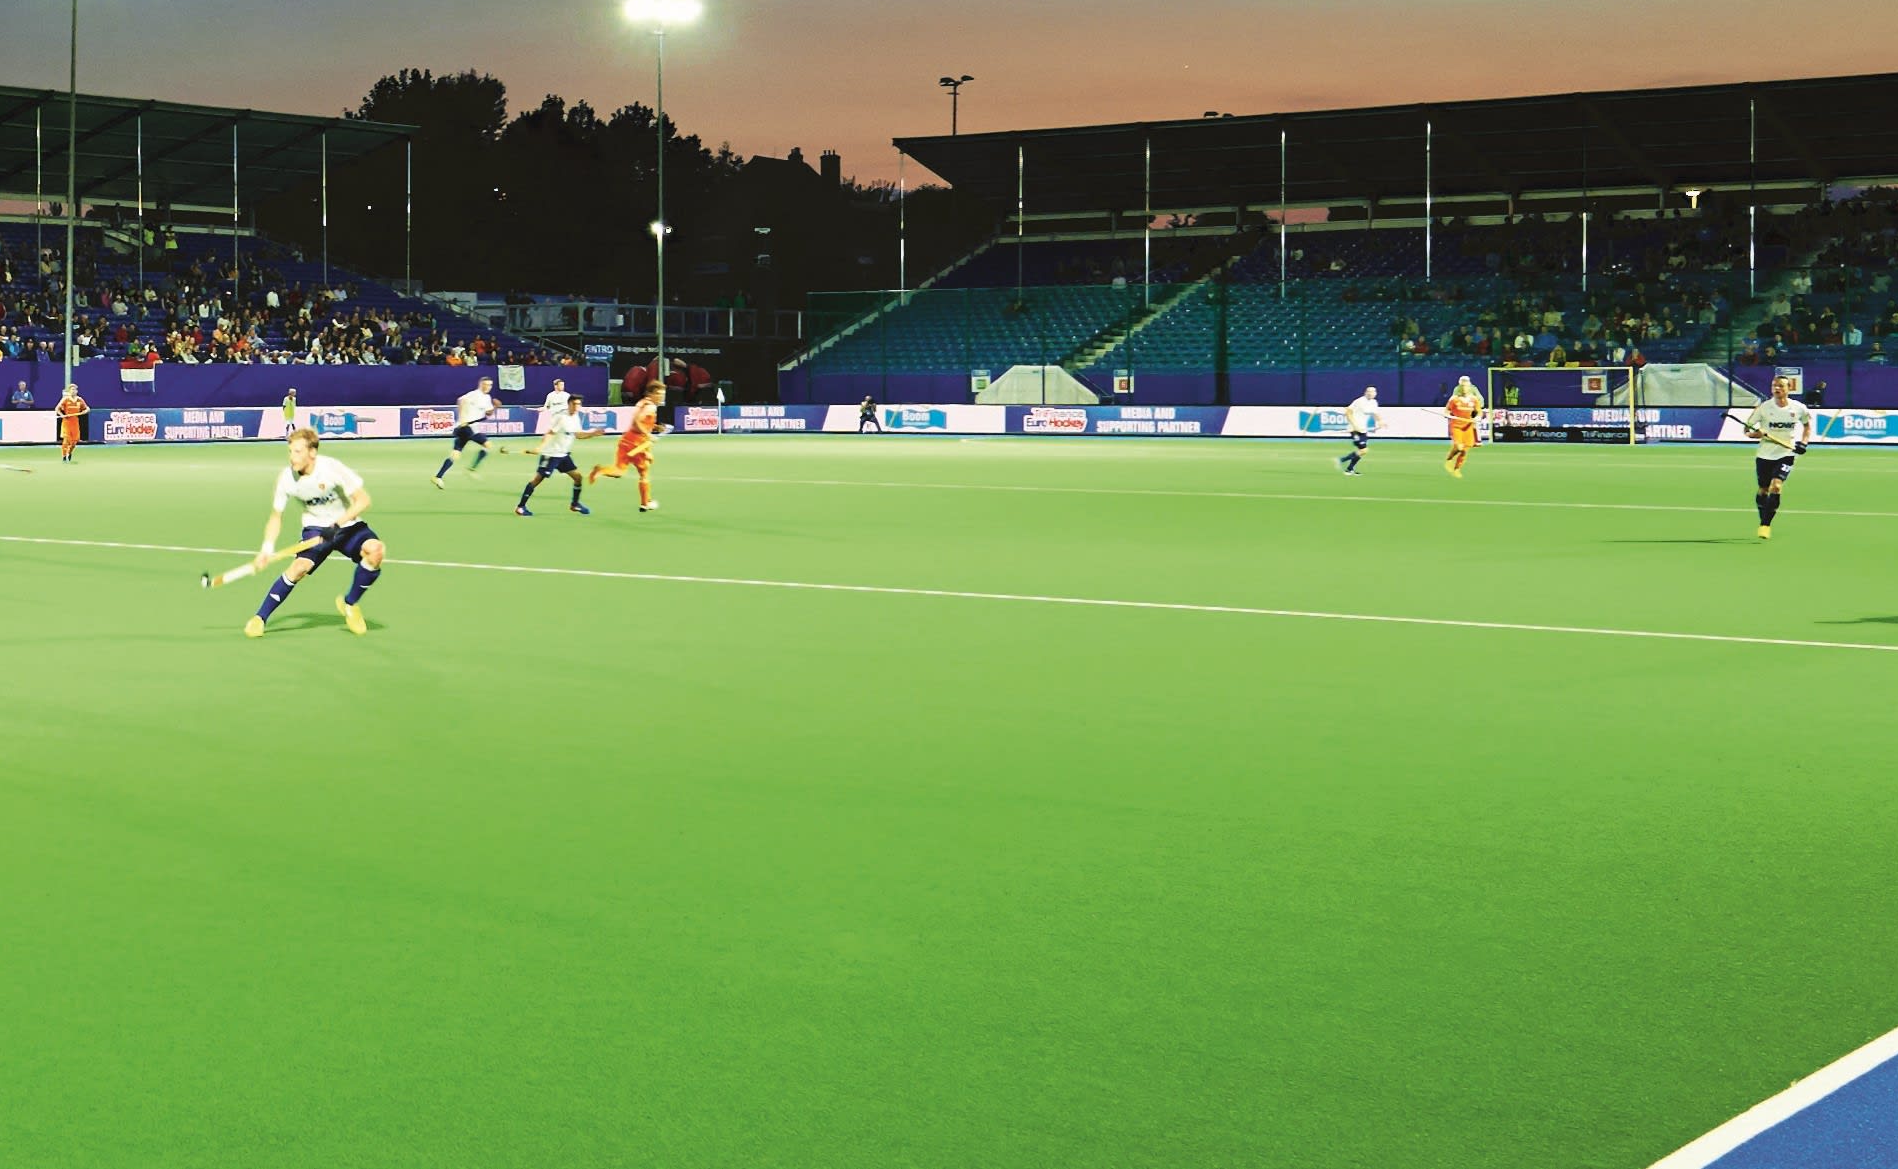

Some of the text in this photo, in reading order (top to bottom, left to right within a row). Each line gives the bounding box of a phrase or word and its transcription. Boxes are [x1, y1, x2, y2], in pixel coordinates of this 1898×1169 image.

[902, 410, 930, 422] Boom
[1121, 407, 1176, 420] MEDIA AND
[1321, 412, 1349, 425] Boo
[106, 422, 156, 435] Euro Hockey
[1026, 416, 1086, 430] Euro Hockey
[1096, 420, 1201, 434] SUPPORTING PARTNER
[1843, 415, 1887, 430] Boom
[1645, 425, 1692, 439] ARTNER
